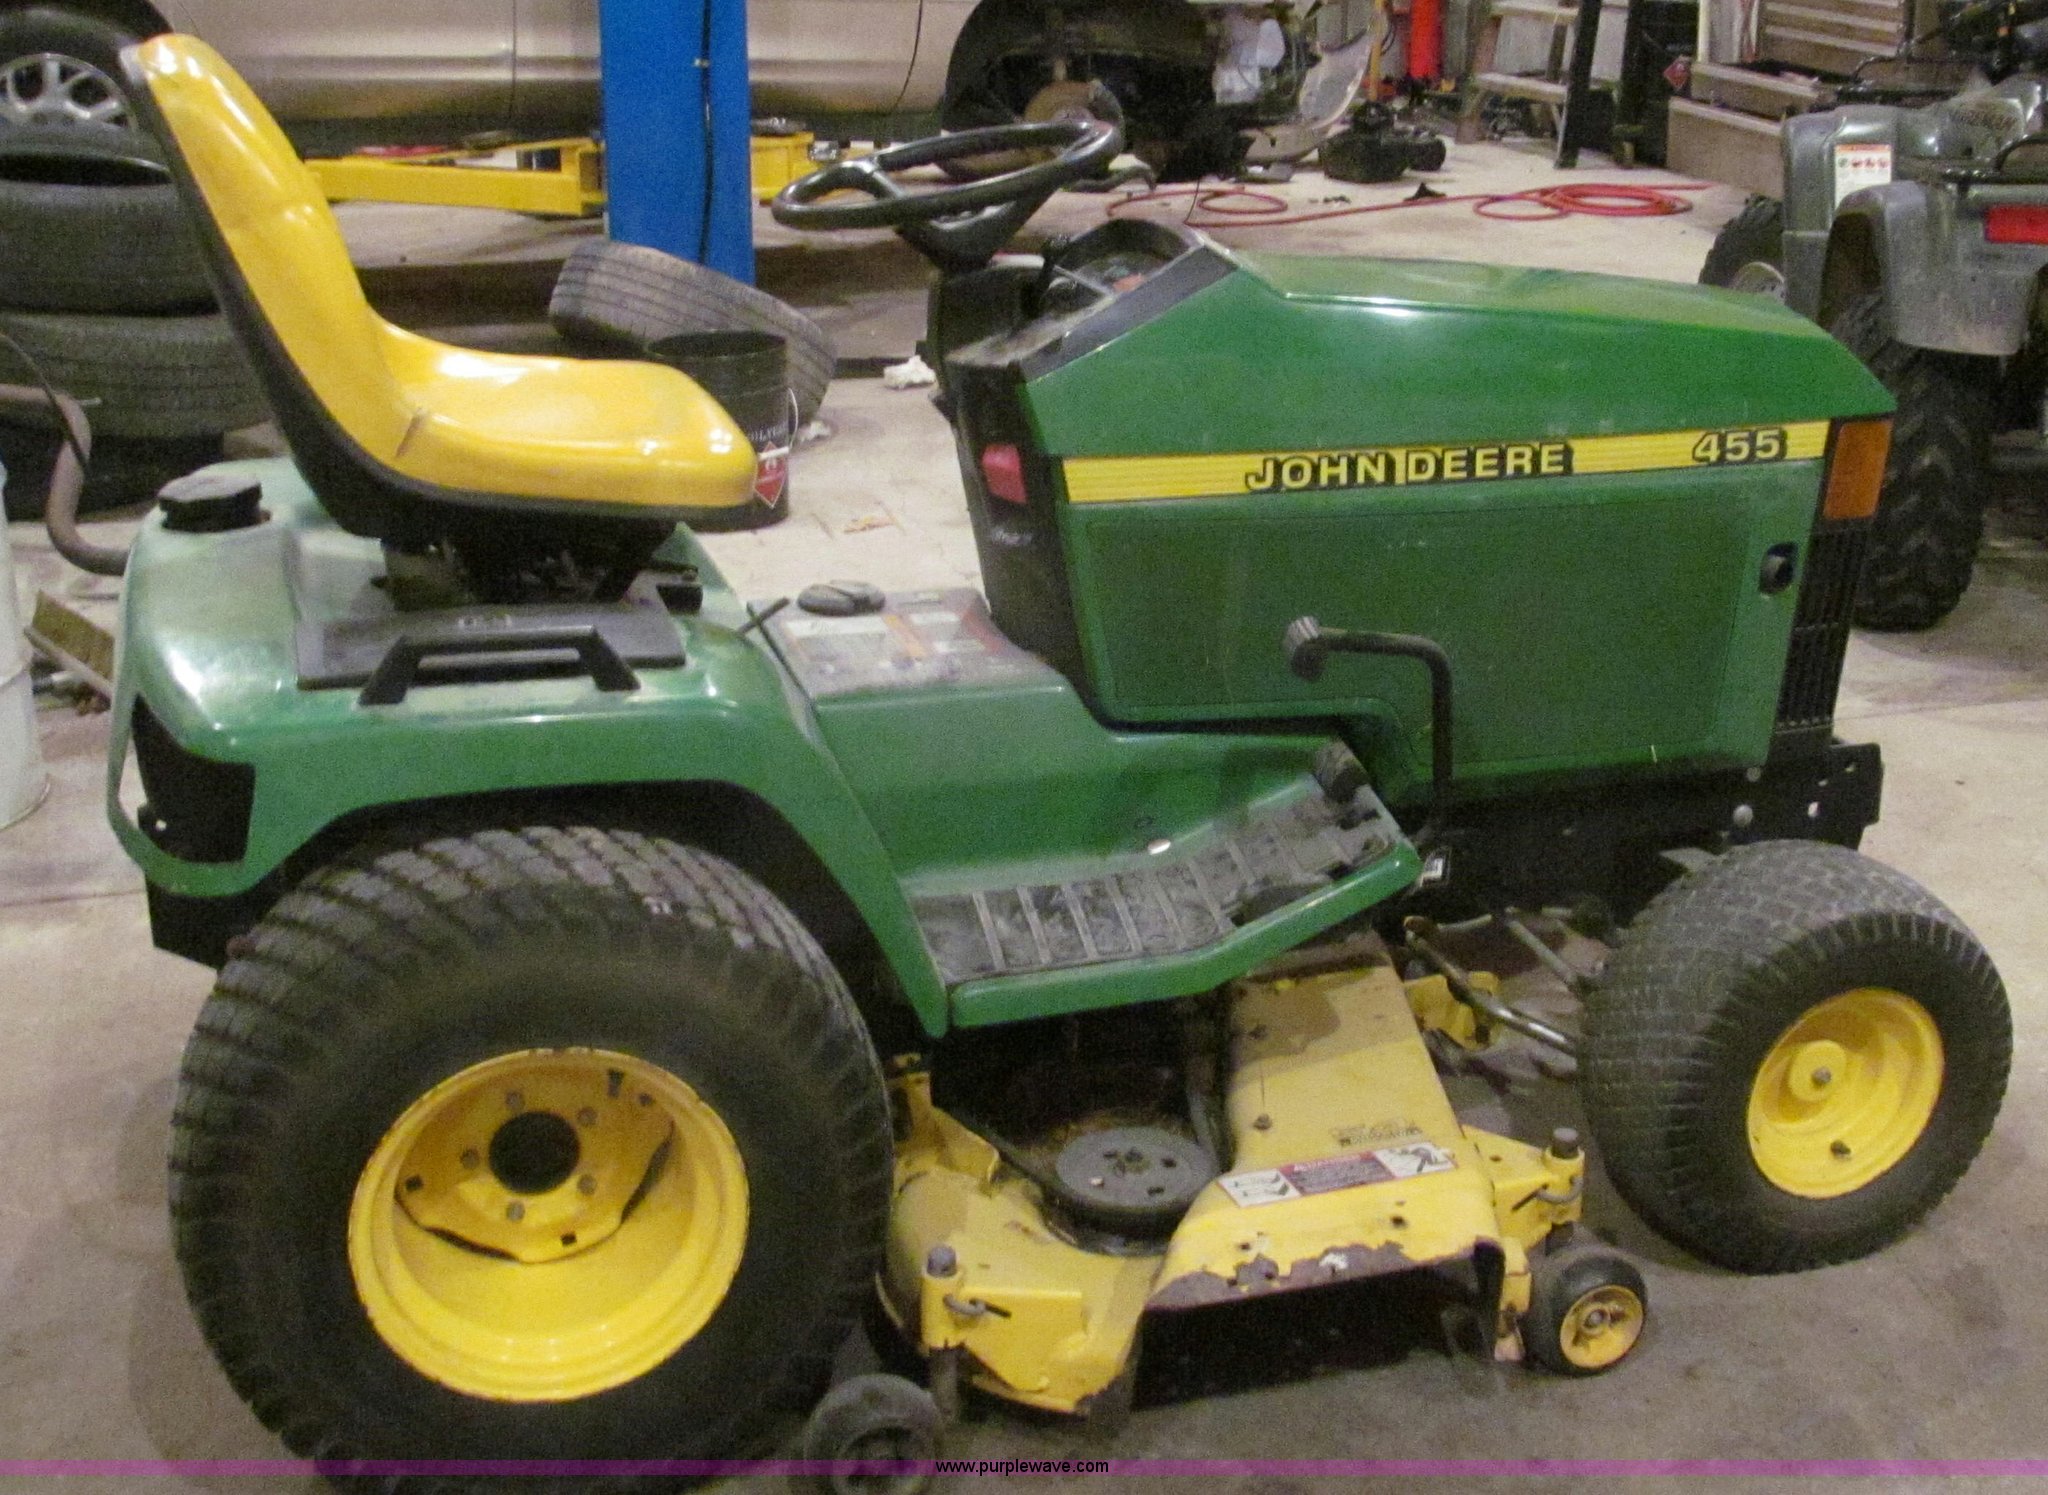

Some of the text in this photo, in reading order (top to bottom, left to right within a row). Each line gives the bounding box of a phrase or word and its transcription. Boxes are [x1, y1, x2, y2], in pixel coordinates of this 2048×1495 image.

[1245, 427, 1787, 493] JOHN DEERE 455
